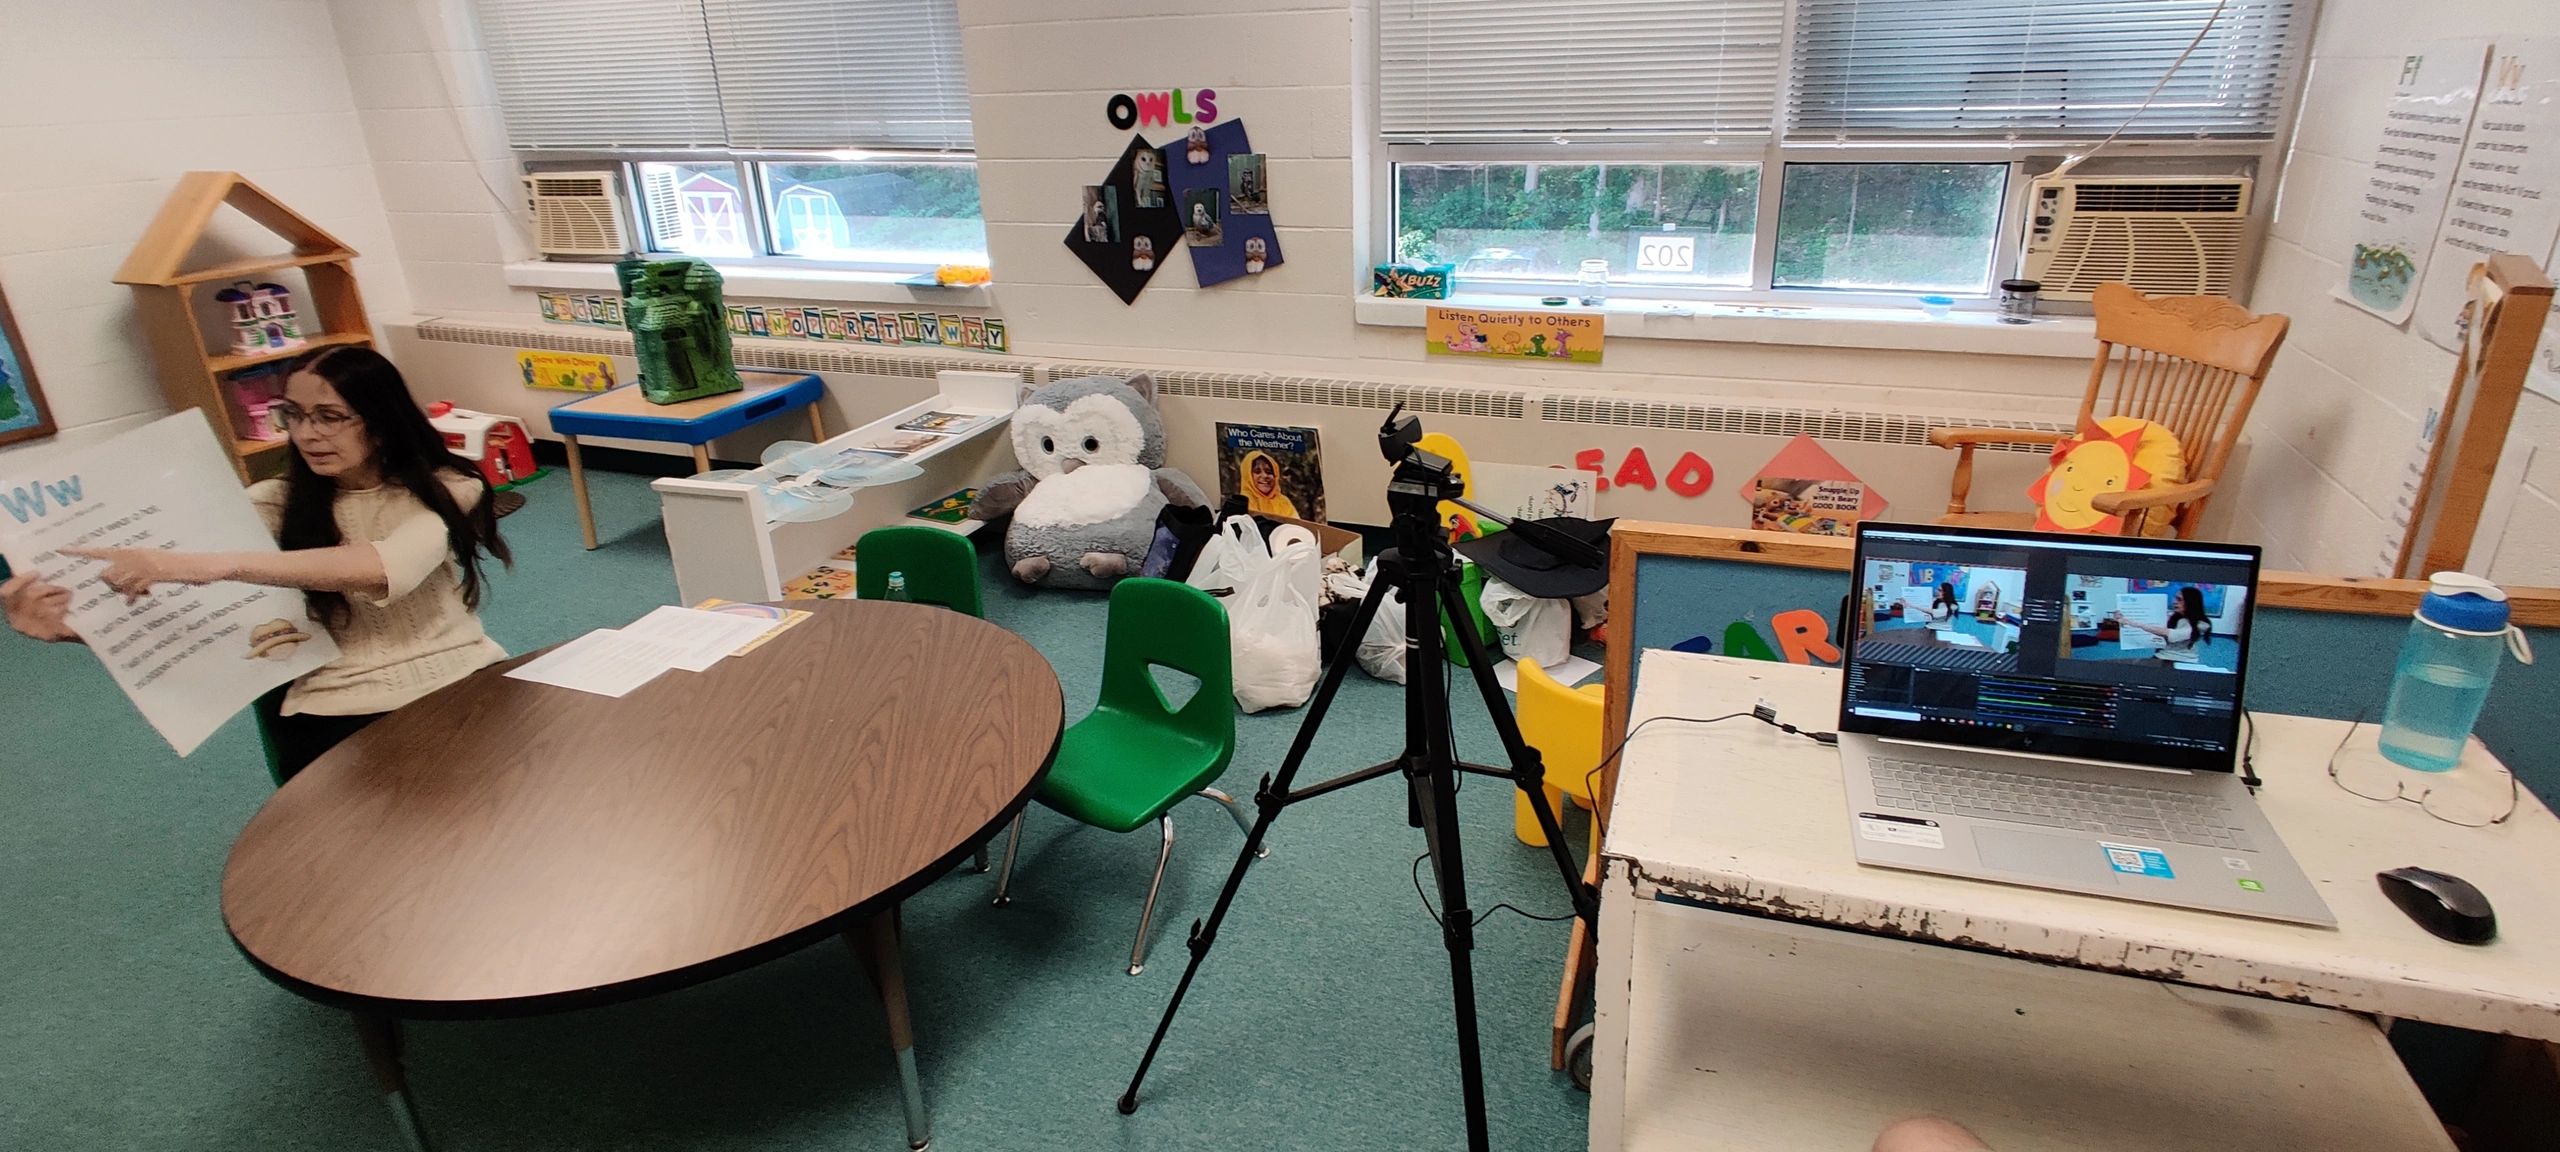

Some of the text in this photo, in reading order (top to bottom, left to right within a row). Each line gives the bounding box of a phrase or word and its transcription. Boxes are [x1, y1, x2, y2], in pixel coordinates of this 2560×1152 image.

[1107, 88, 1218, 130] OWLS
[1407, 274, 1442, 287] BUZZ
[1438, 309, 1591, 328] Listen Quietly to Others
[1228, 428, 1303, 442] Who Cares About
[1238, 438, 1295, 450] the Weather?
[1574, 447, 1714, 498] EAD
[0, 475, 82, 523] Ww
[1837, 495, 1858, 504] Beary
[1500, 631, 1518, 647] et
